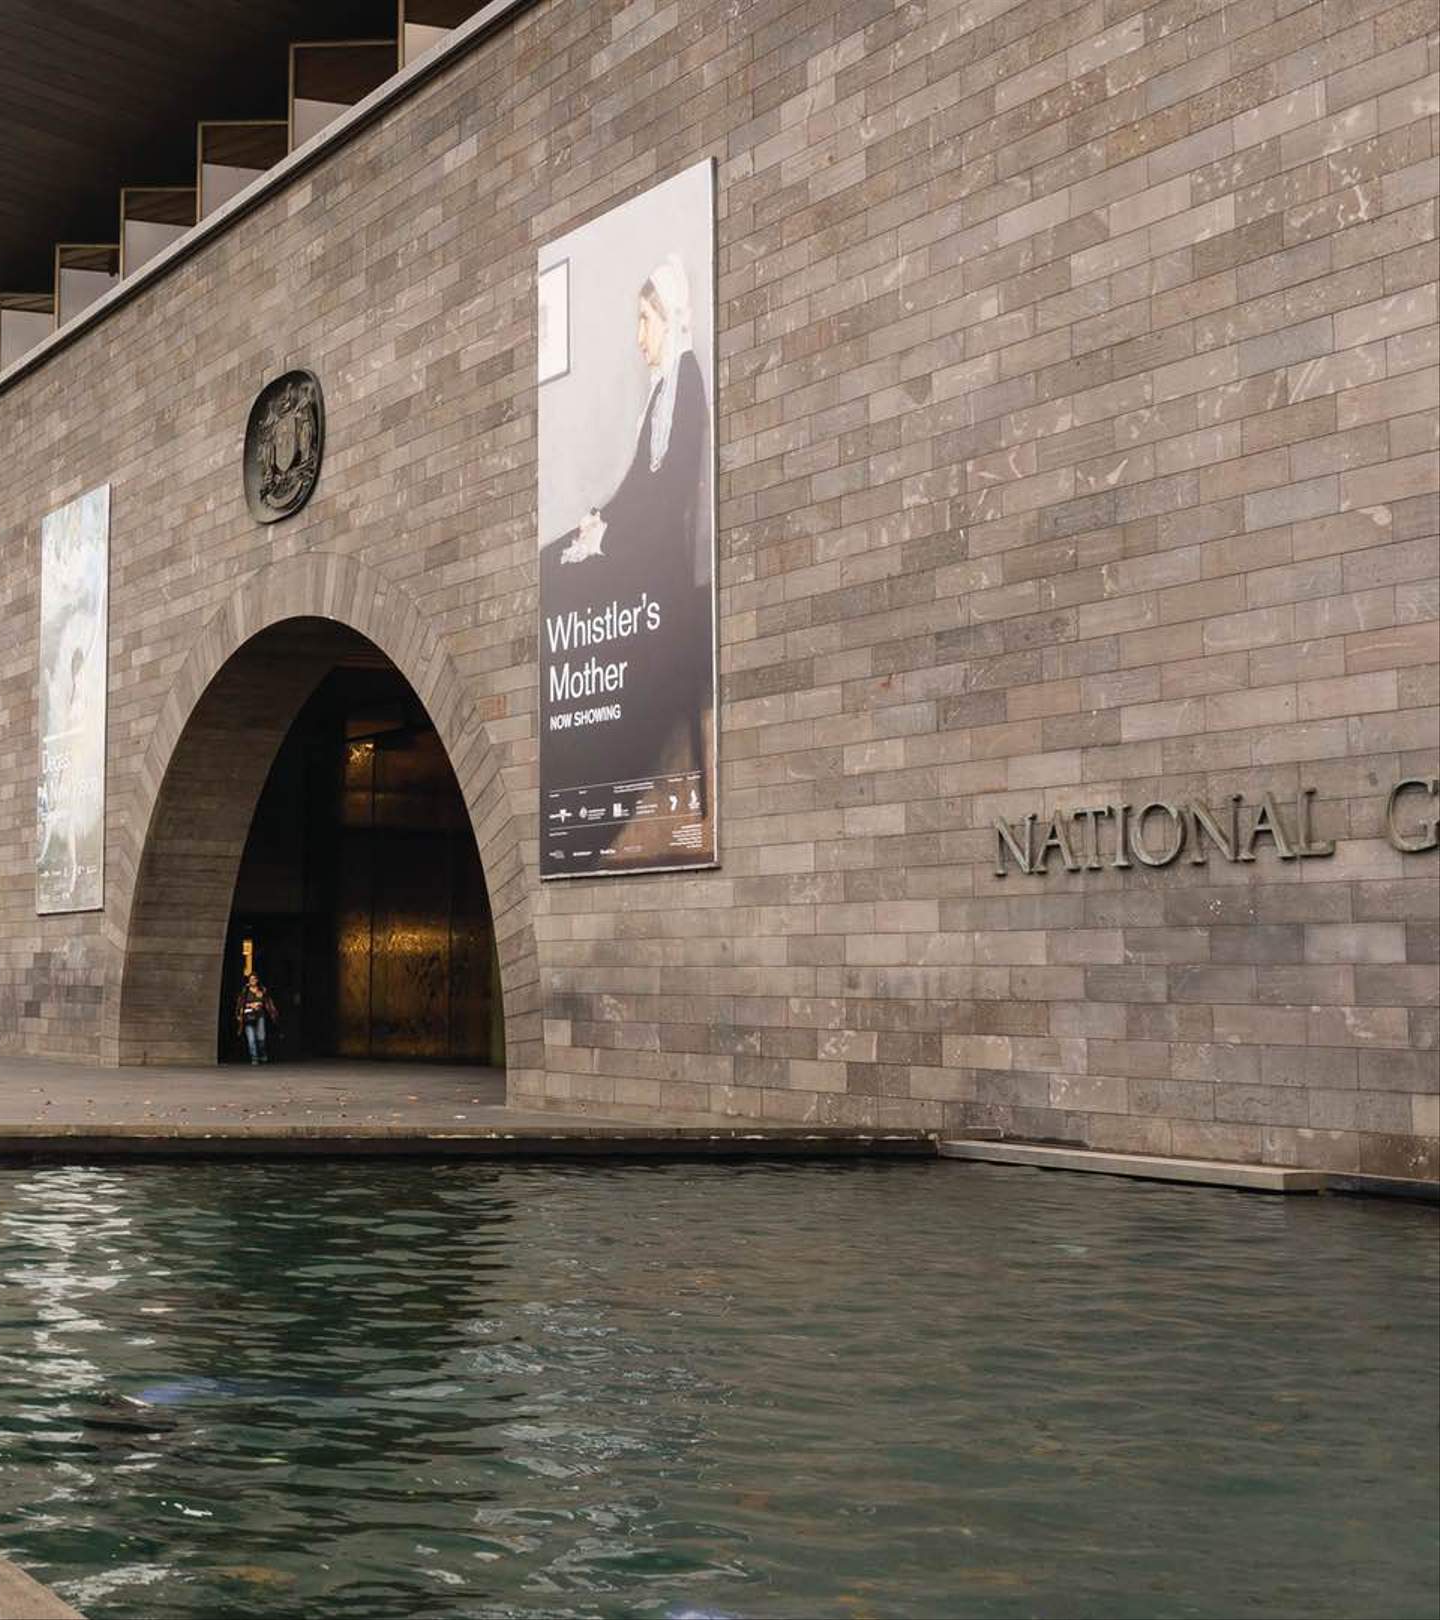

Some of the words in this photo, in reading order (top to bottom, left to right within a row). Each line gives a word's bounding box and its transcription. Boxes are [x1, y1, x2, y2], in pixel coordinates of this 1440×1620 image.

[546, 592, 661, 654] Whistler's
[549, 656, 628, 703] Mother
[549, 711, 572, 731] NOW
[573, 703, 622, 727] SHOWING
[994, 787, 1336, 876] NATIONAL
